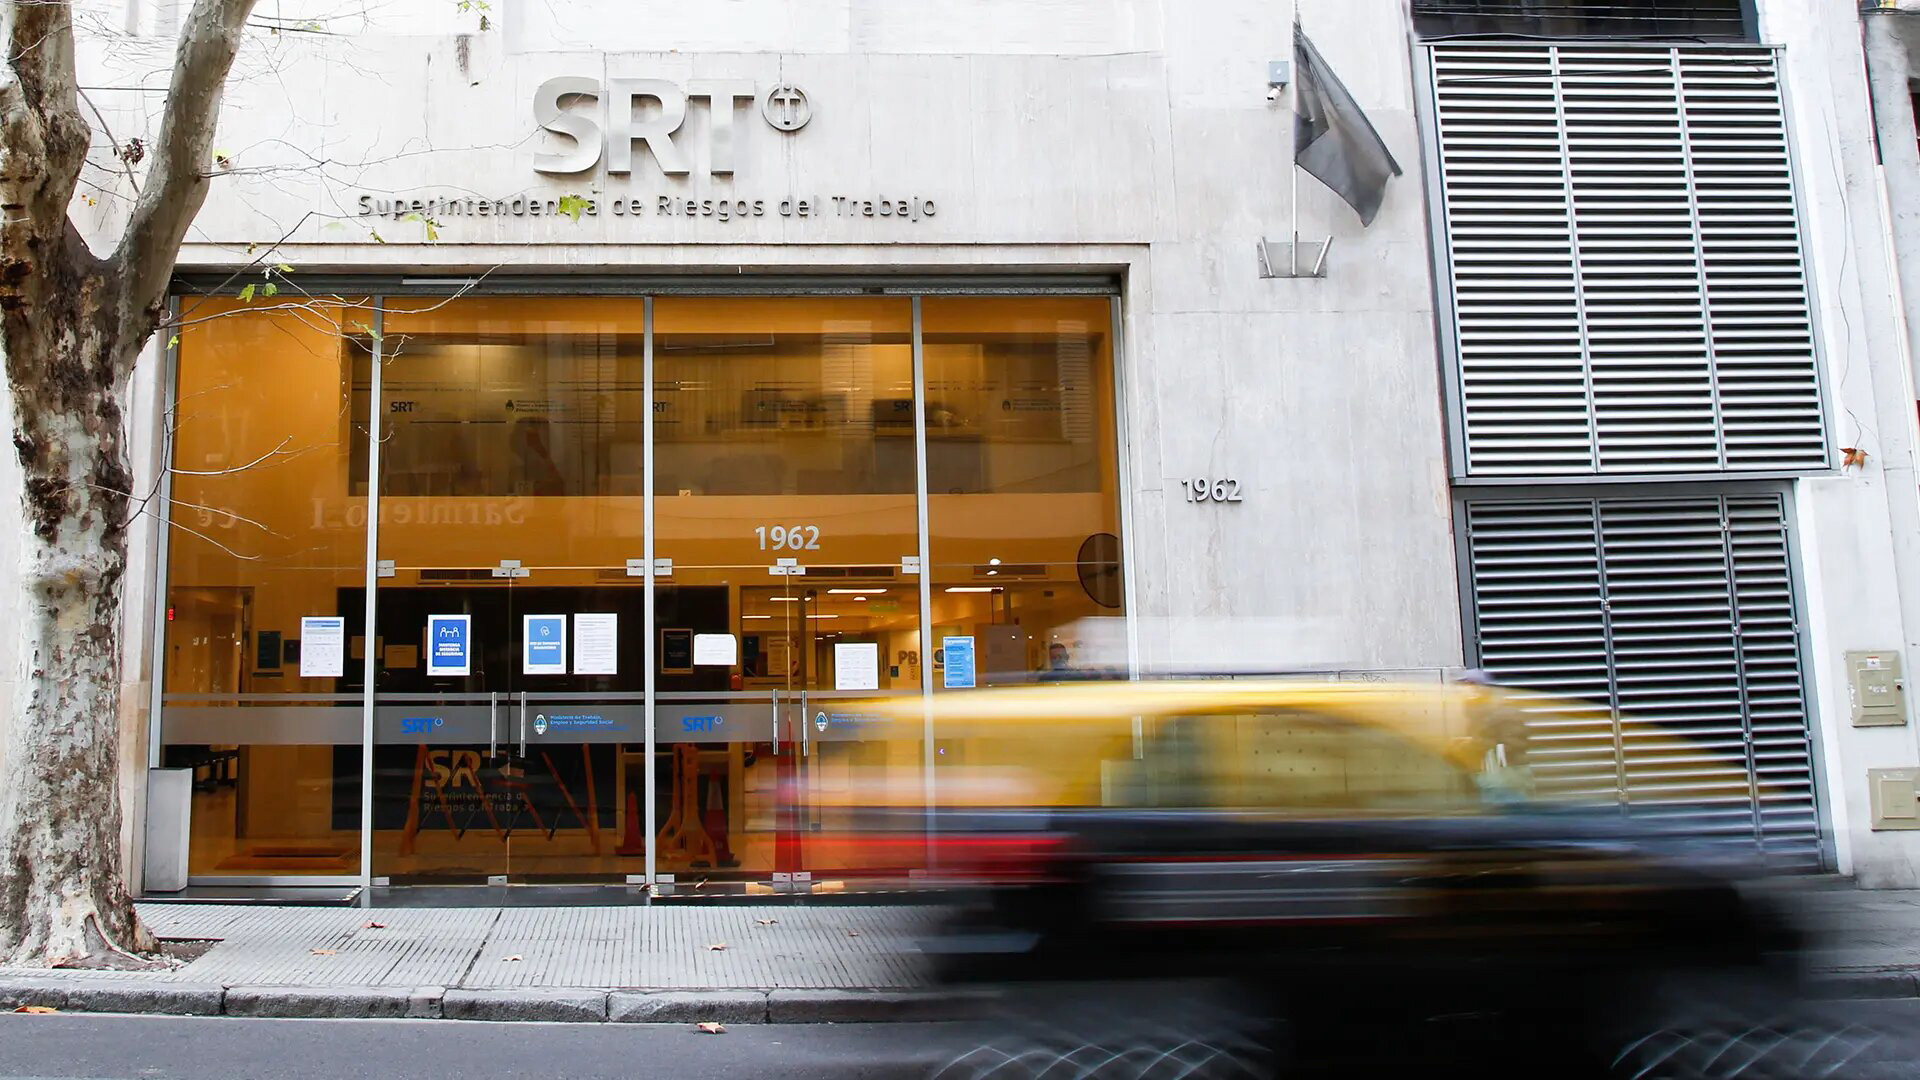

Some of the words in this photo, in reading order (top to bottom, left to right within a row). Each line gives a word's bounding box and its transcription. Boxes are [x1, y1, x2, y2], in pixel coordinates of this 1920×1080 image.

[534, 76, 755, 175] SRT
[358, 195, 598, 220] Superintendena
[612, 194, 642, 216] de
[656, 195, 765, 222] Riesgos
[778, 194, 818, 217] del
[831, 195, 937, 222] Trabajo
[391, 401, 414, 413] SRT
[1181, 477, 1243, 503] 1962
[755, 526, 820, 550] 1962
[898, 650, 918, 664] PB
[401, 717, 433, 734] SRT
[682, 715, 714, 733] SRT
